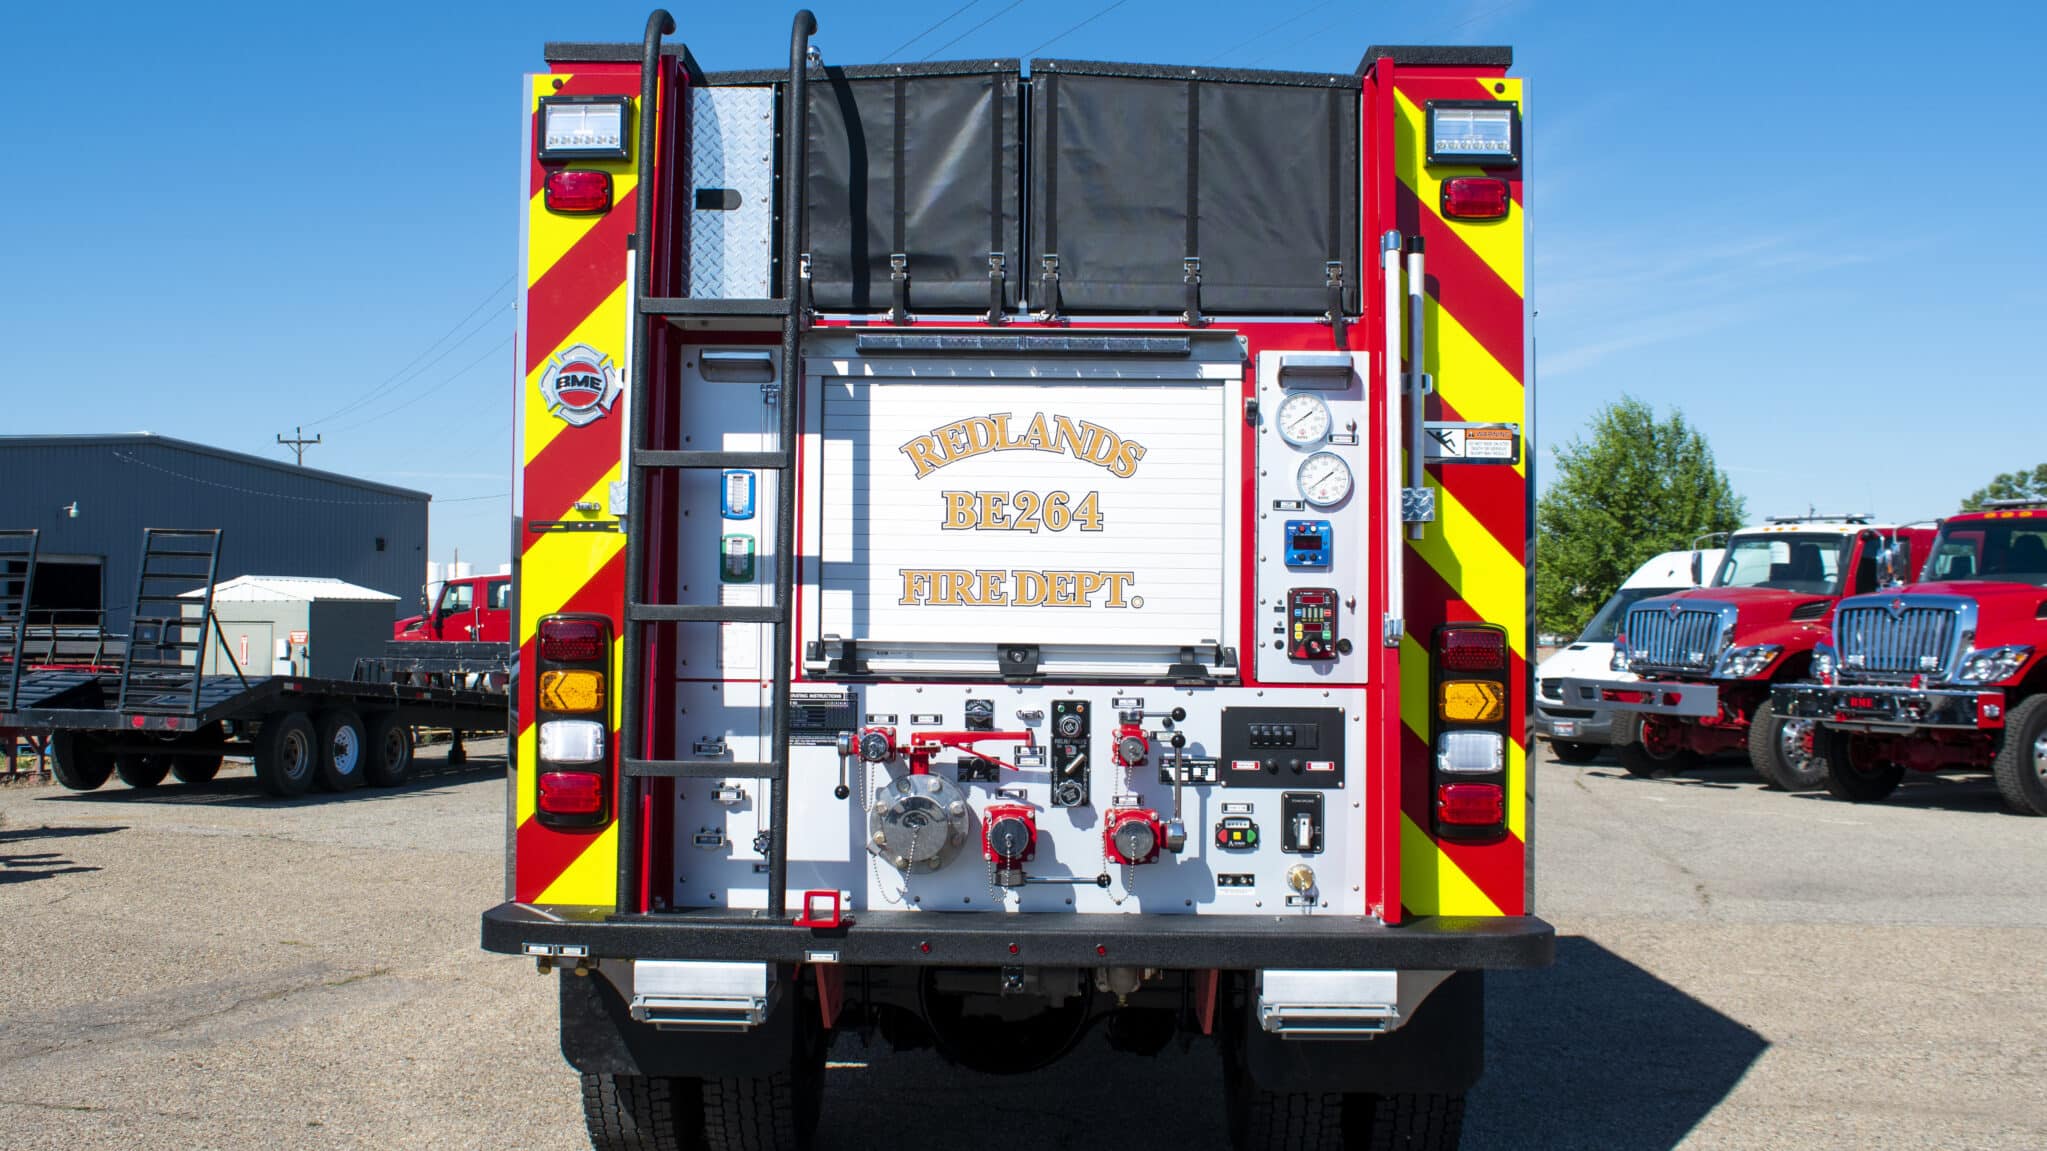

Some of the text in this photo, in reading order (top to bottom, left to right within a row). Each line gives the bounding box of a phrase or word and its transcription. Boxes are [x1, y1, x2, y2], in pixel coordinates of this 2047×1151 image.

[556, 375, 602, 391] BME
[899, 412, 1147, 479] REDLANDS
[941, 490, 1104, 533] BE264
[899, 569, 1144, 608] FIRE DEPT.
